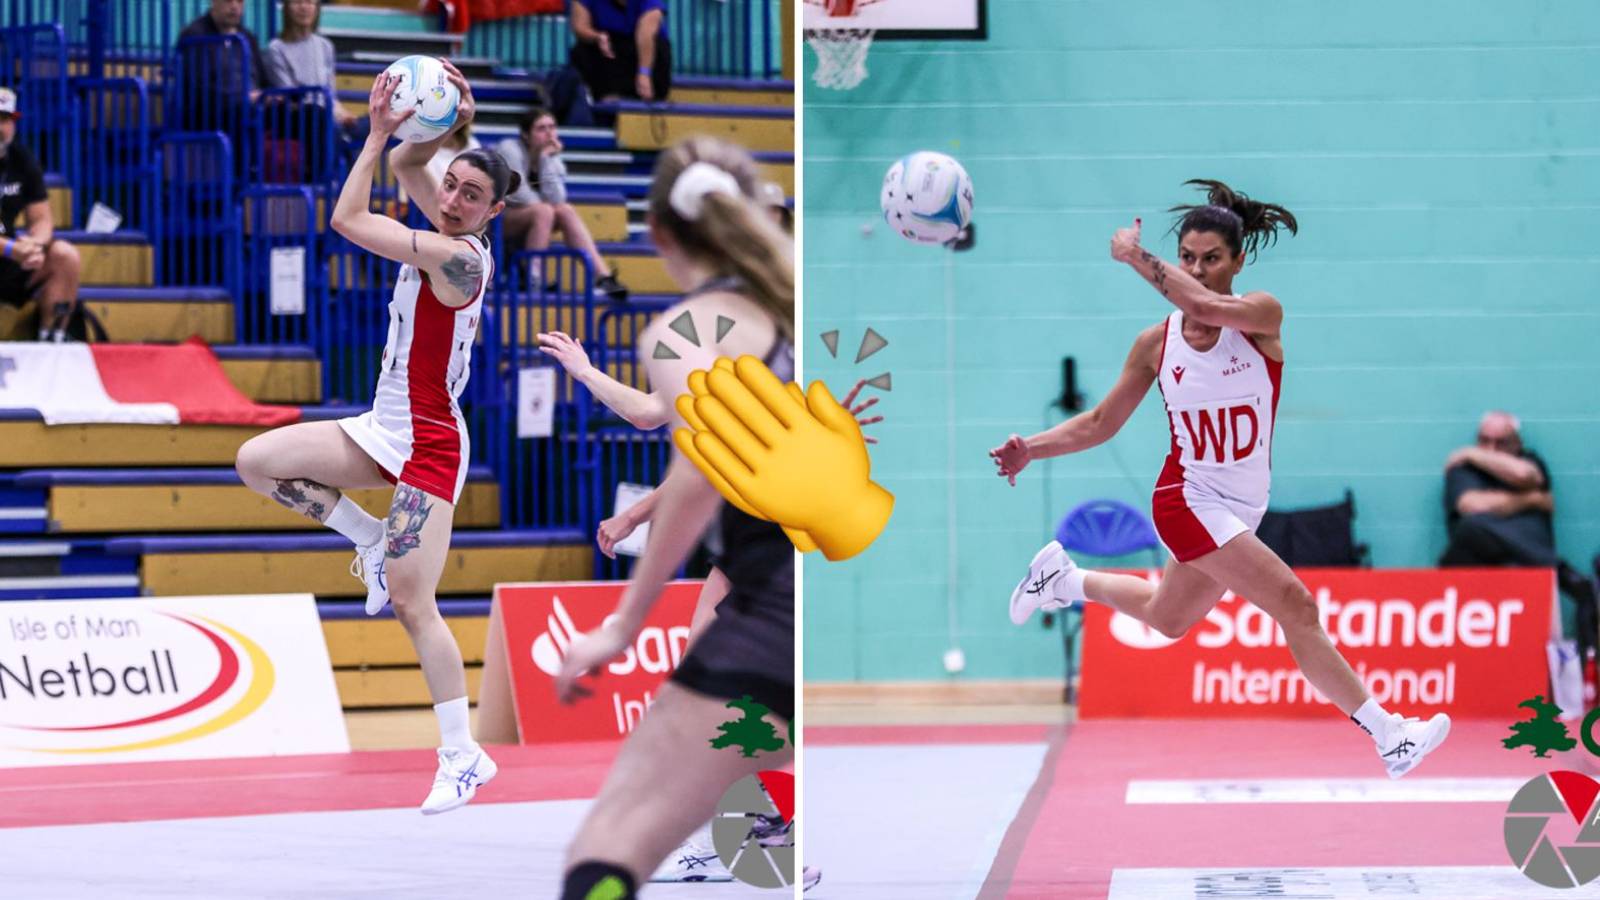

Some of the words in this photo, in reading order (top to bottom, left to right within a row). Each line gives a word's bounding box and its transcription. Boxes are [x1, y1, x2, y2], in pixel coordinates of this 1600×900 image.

[1222, 362, 1251, 377] MALTA
[1181, 404, 1259, 464] WD
[9, 616, 47, 641] Isle
[54, 614, 78, 641] of
[85, 616, 141, 639] Man
[1196, 586, 1525, 648] Satander
[0, 649, 179, 699] Netball
[1192, 661, 1456, 705] Internional
